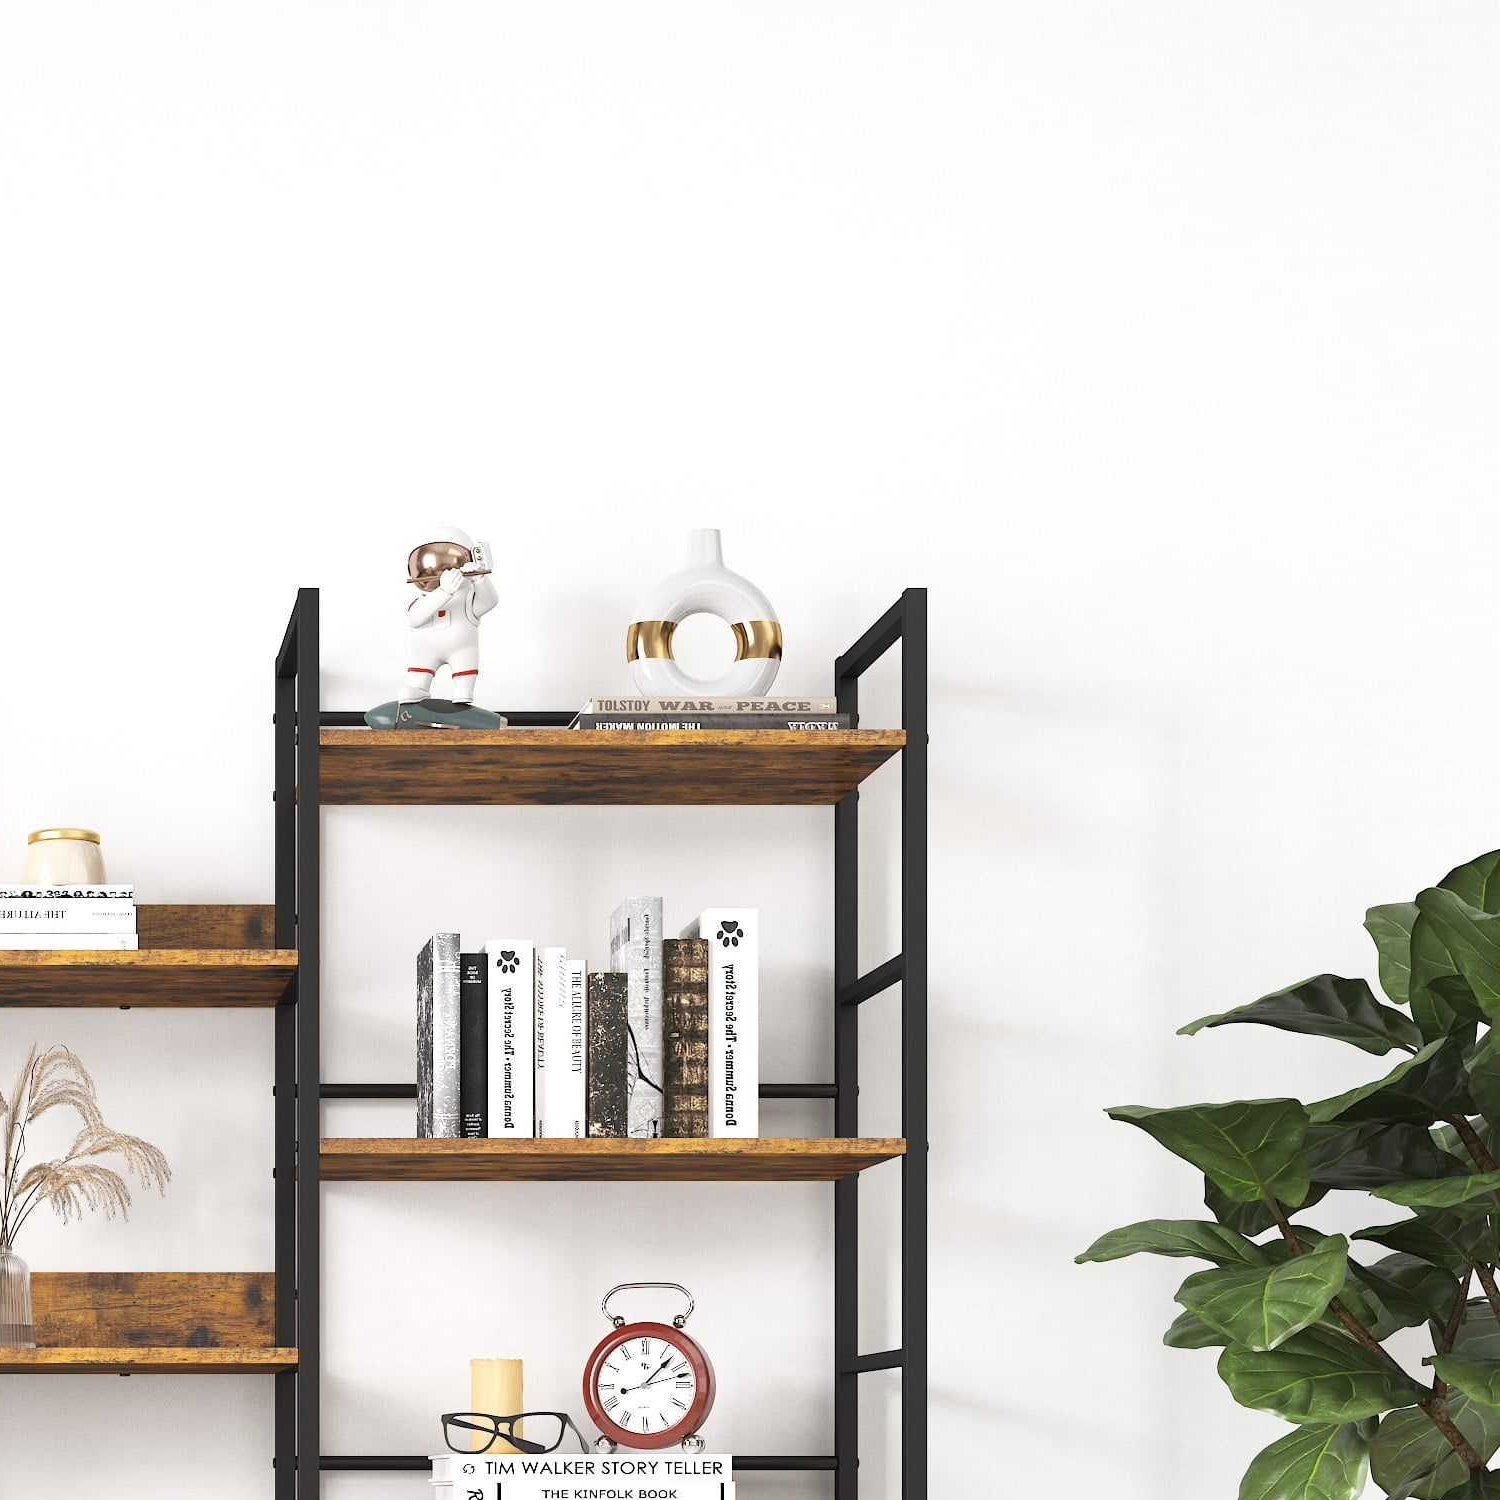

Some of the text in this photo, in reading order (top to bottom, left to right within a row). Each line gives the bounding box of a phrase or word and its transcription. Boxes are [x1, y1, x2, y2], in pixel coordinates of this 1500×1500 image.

[598, 700, 650, 712] TOLSTOY
[658, 701, 714, 711] WAR
[736, 701, 811, 712] PEACE
[485, 1462, 722, 1474] TIM WALKER STORY TELLER
[542, 1490, 677, 1499] THE KINFOLK BOOK
